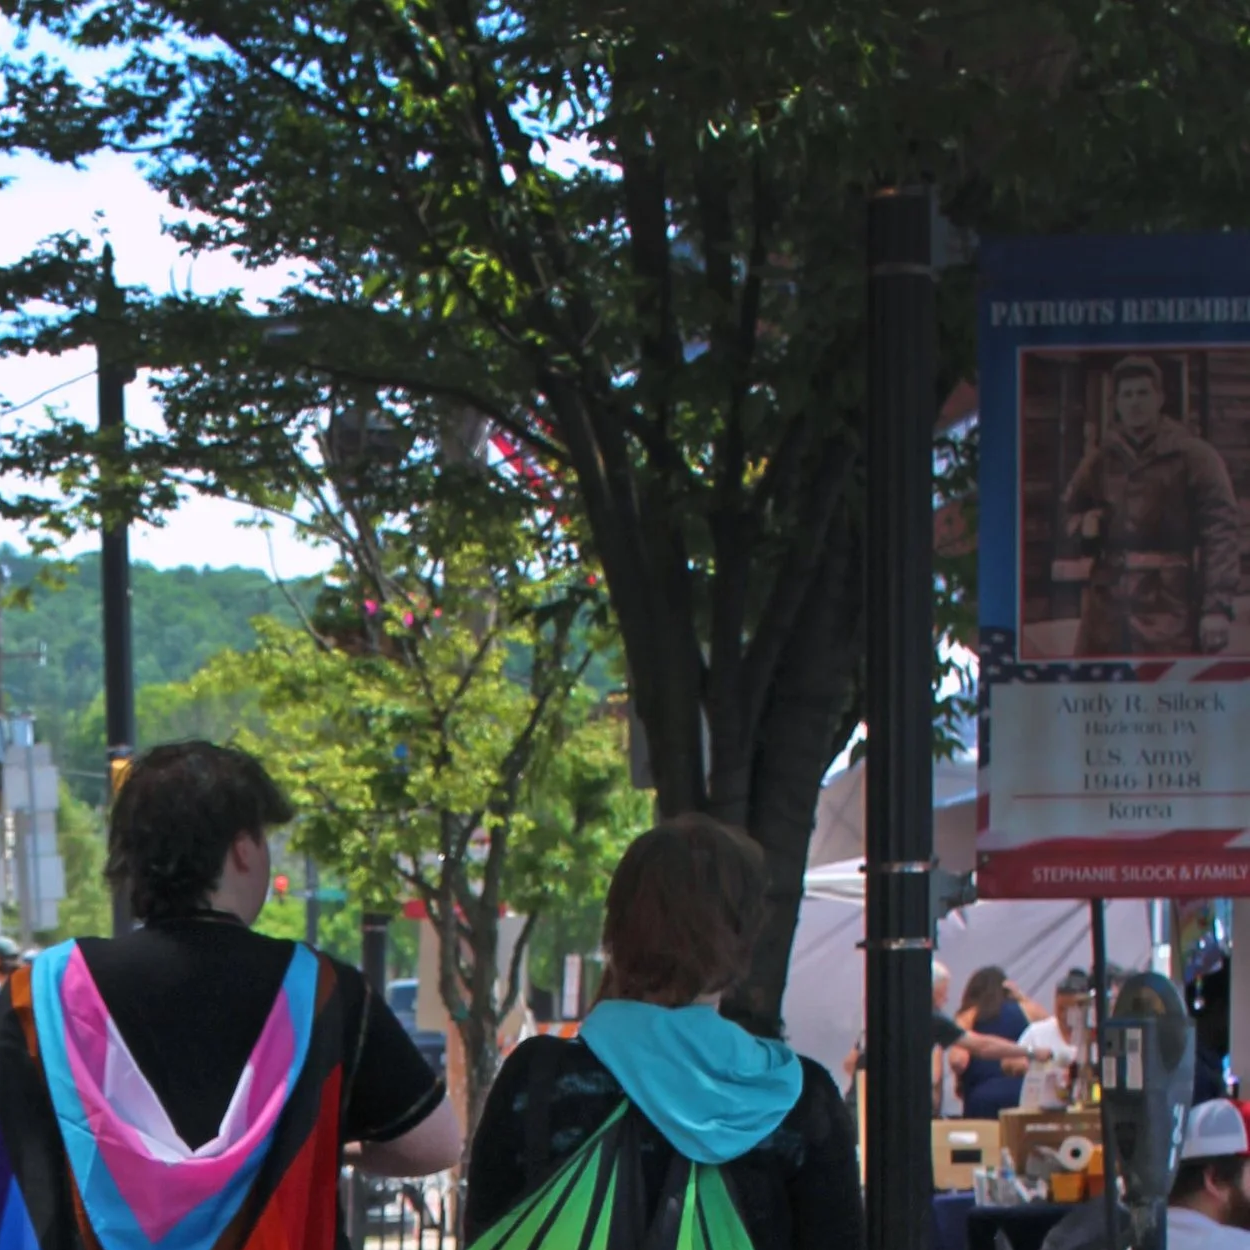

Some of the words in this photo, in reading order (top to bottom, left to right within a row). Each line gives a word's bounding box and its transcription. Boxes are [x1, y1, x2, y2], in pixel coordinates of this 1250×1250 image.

[990, 301, 1115, 328] PATRIOTS
[1121, 297, 1250, 324] REMEMBE
[1057, 692, 1117, 717] Andy
[1125, 694, 1147, 713] R.
[1157, 692, 1226, 713] Silock
[1173, 720, 1197, 735] PA
[1085, 749, 1125, 767] U.S.
[1136, 748, 1196, 770] Army
[1108, 801, 1172, 820] Korea
[1032, 865, 1117, 883] STEPHANIE
[1121, 865, 1176, 881] SILOCK
[1178, 865, 1192, 881] &
[1194, 864, 1248, 880] FAMILY
